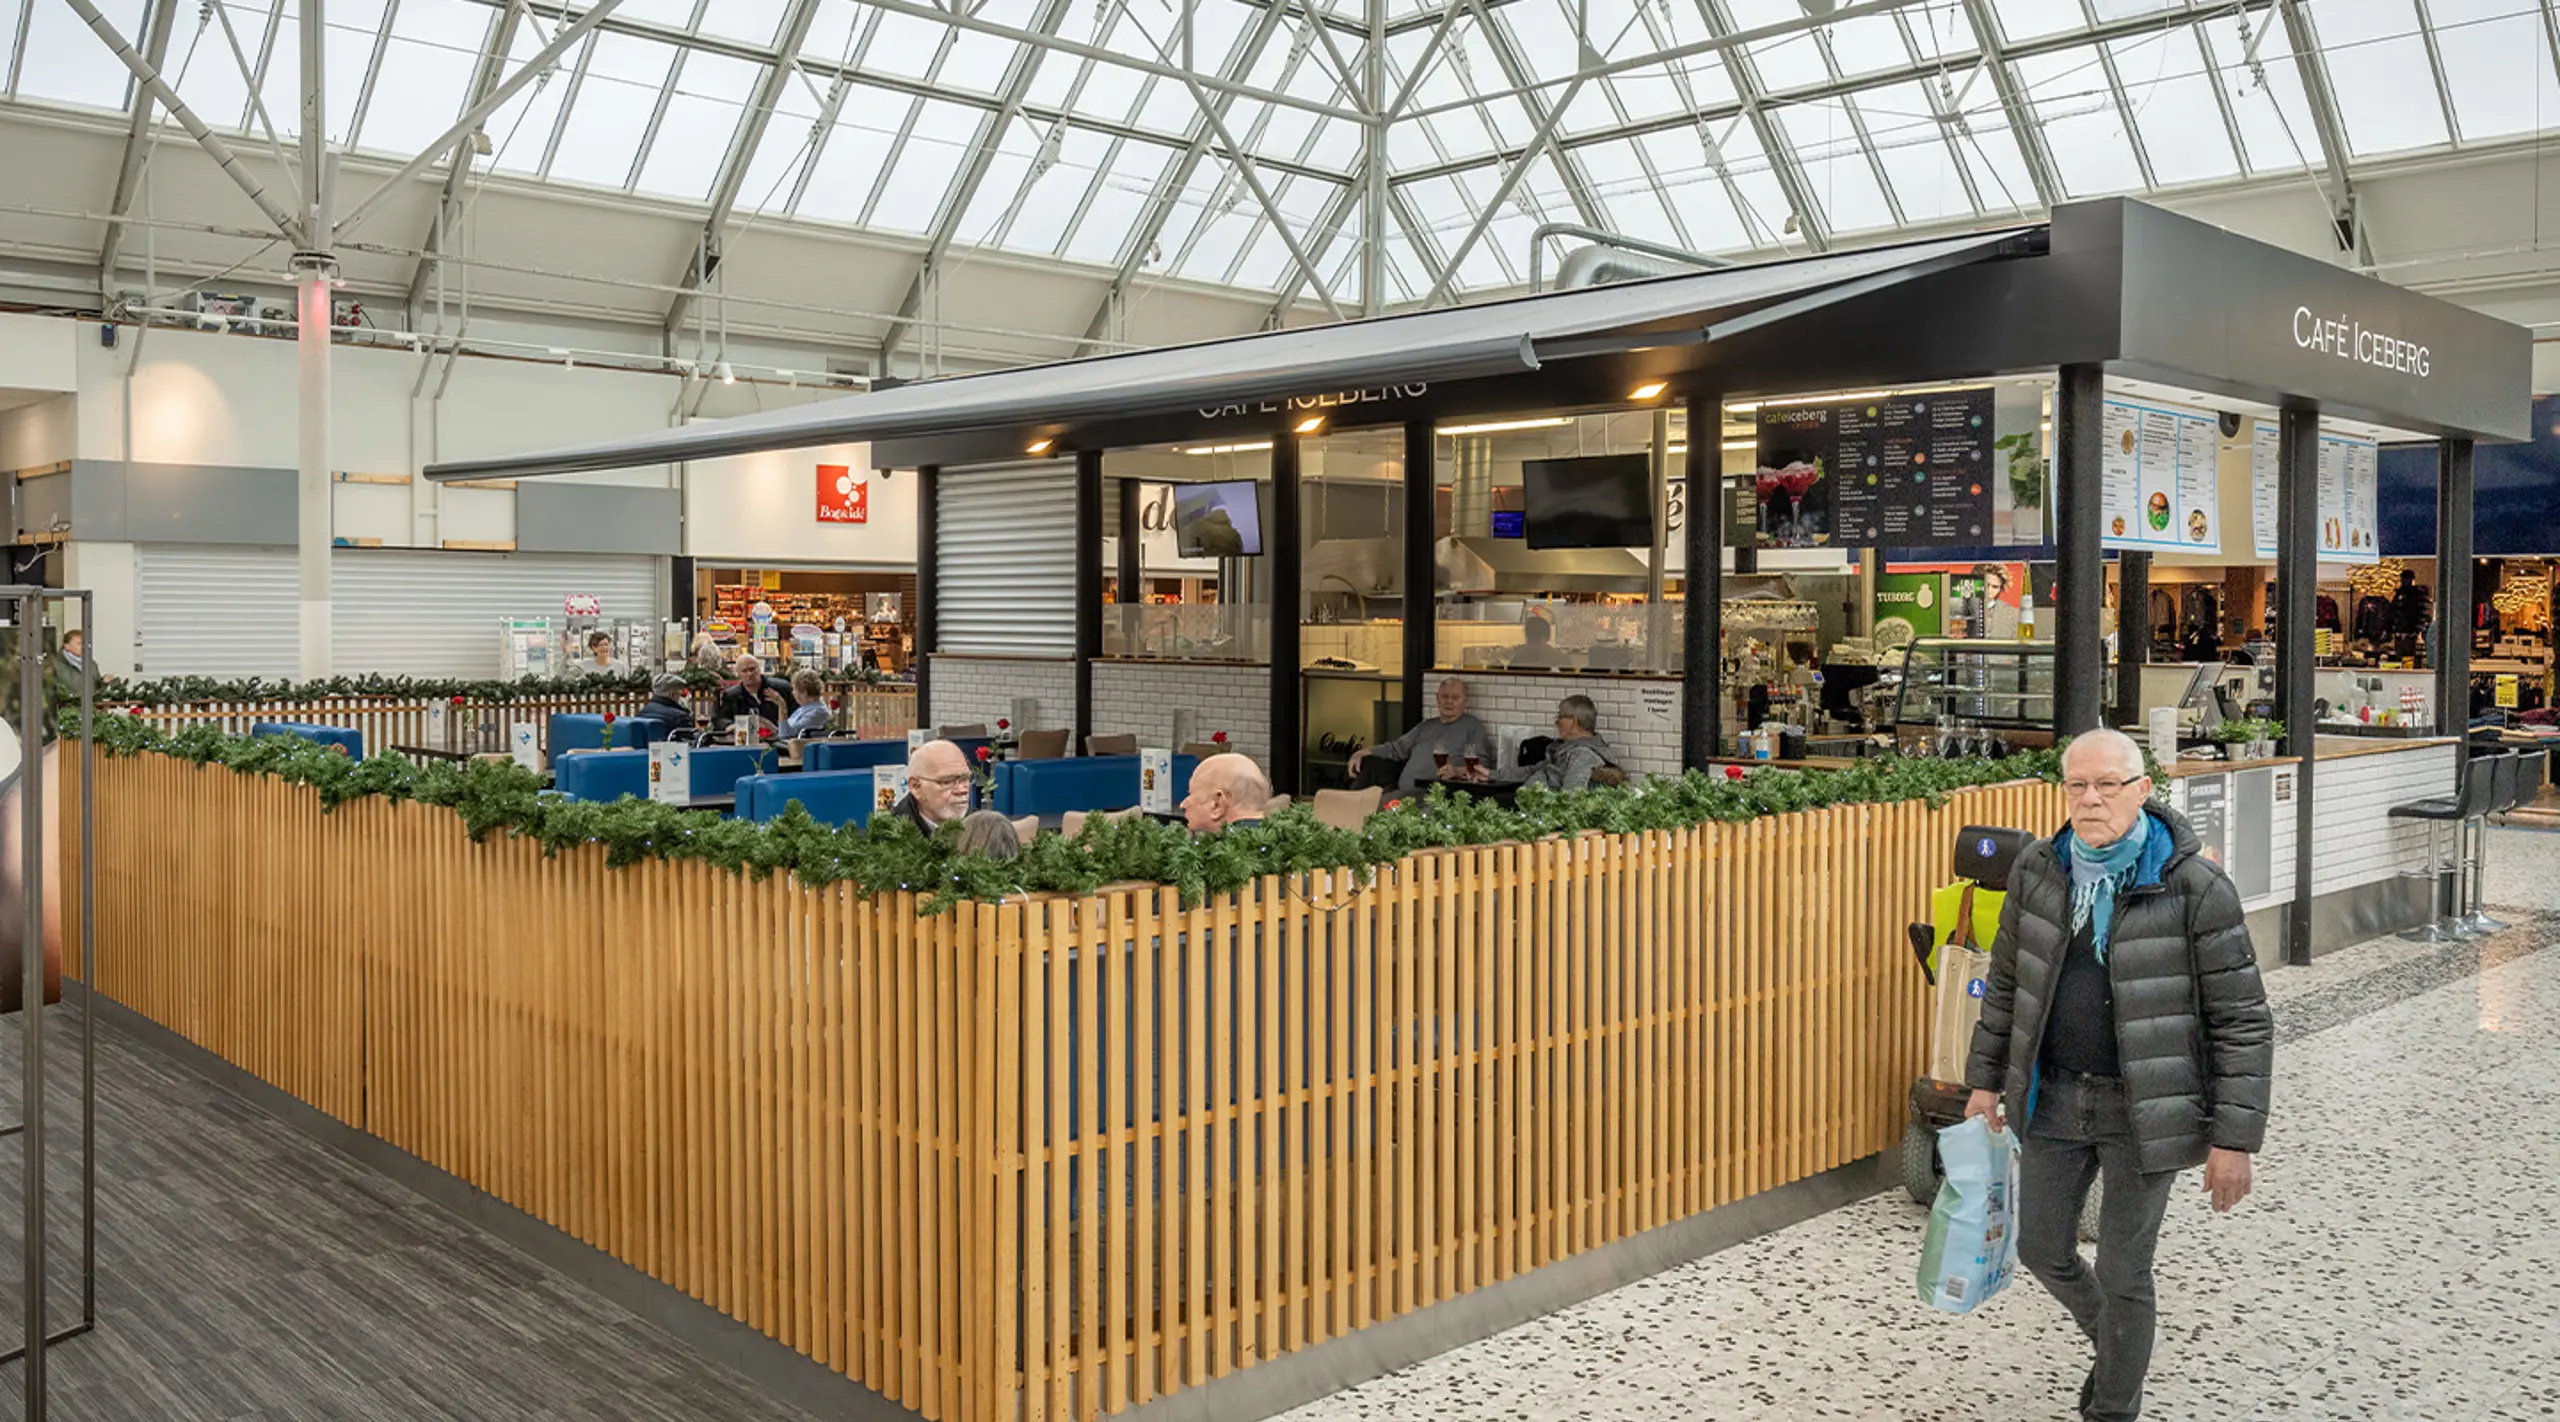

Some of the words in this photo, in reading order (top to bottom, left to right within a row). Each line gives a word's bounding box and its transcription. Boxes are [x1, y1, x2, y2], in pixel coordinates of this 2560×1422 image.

[2293, 306, 2349, 358] CAFÉ
[2353, 321, 2430, 377] ICEBERG
[1877, 592, 1916, 602] TUBORG
